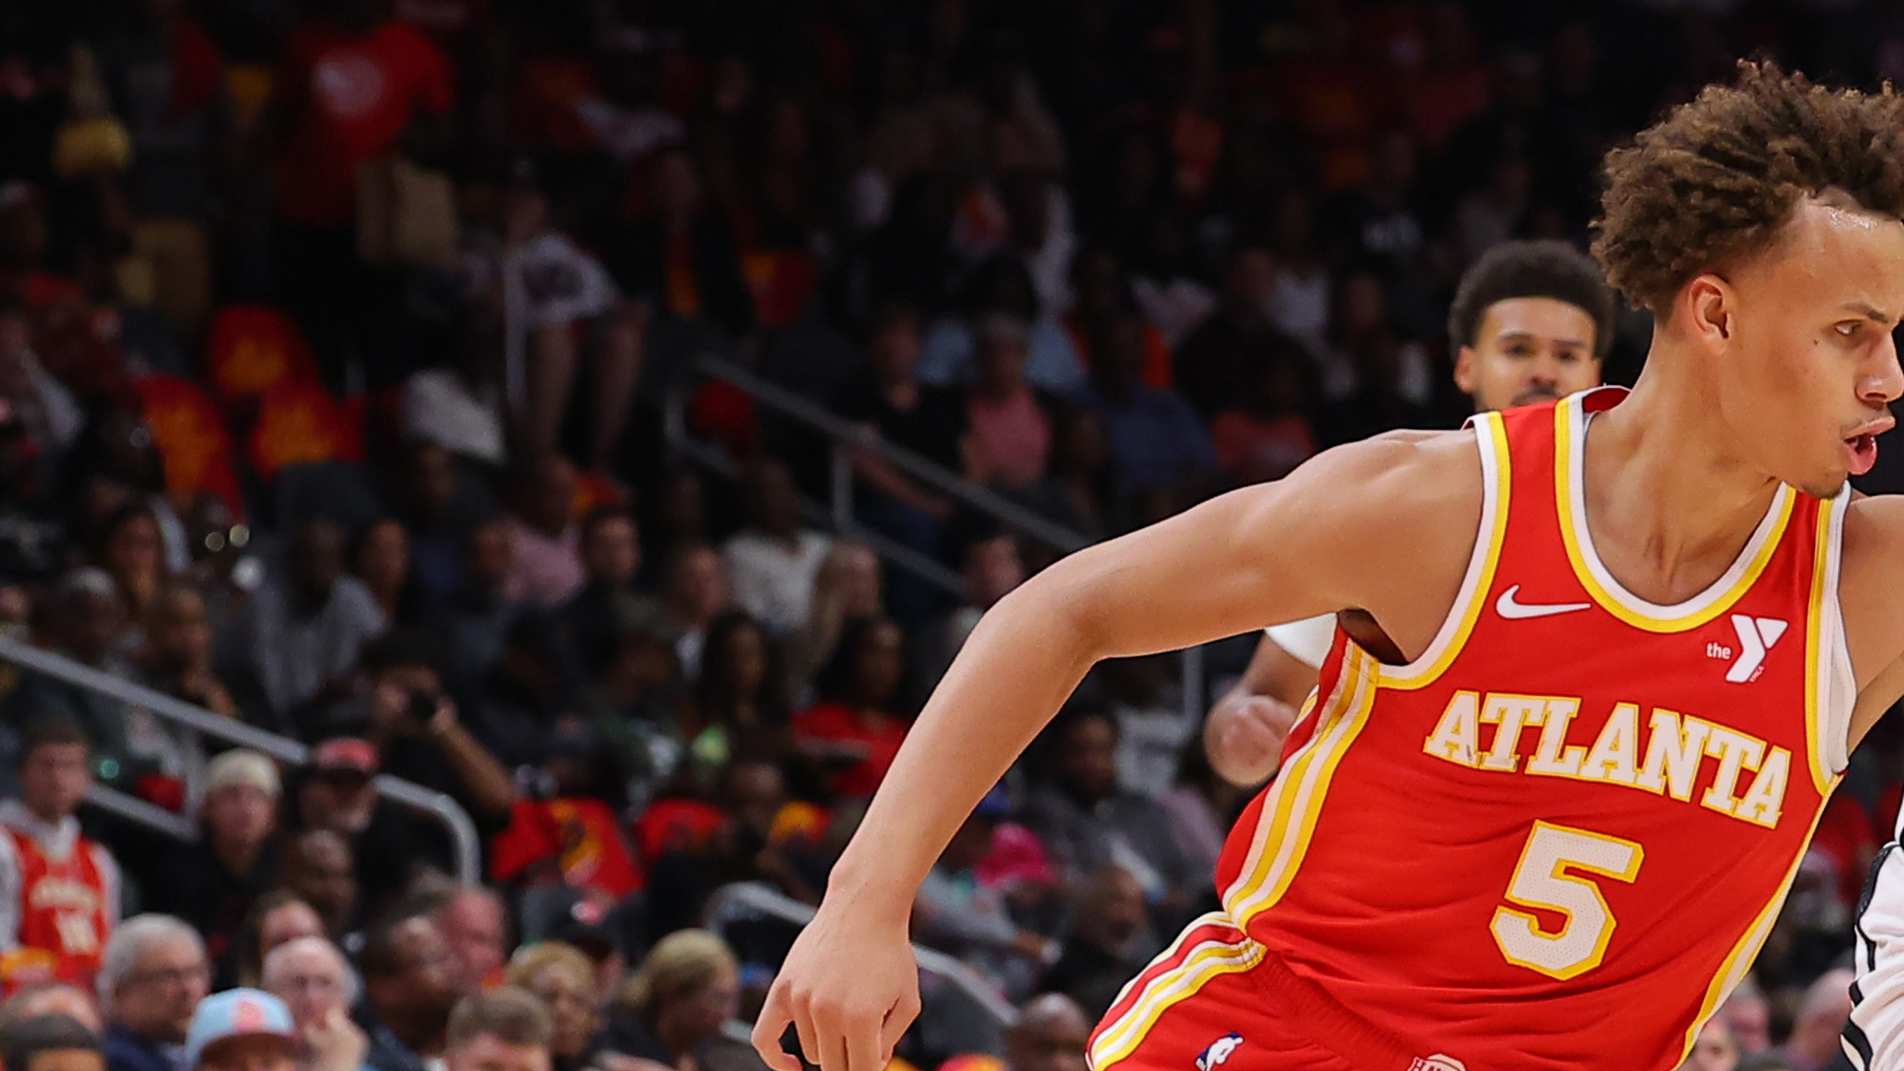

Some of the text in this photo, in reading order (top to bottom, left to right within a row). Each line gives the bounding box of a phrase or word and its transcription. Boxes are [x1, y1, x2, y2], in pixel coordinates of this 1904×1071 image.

[1706, 613, 1788, 683] the Y
[1422, 689, 1792, 830] ATLANTA
[1488, 818, 1645, 981] 5
